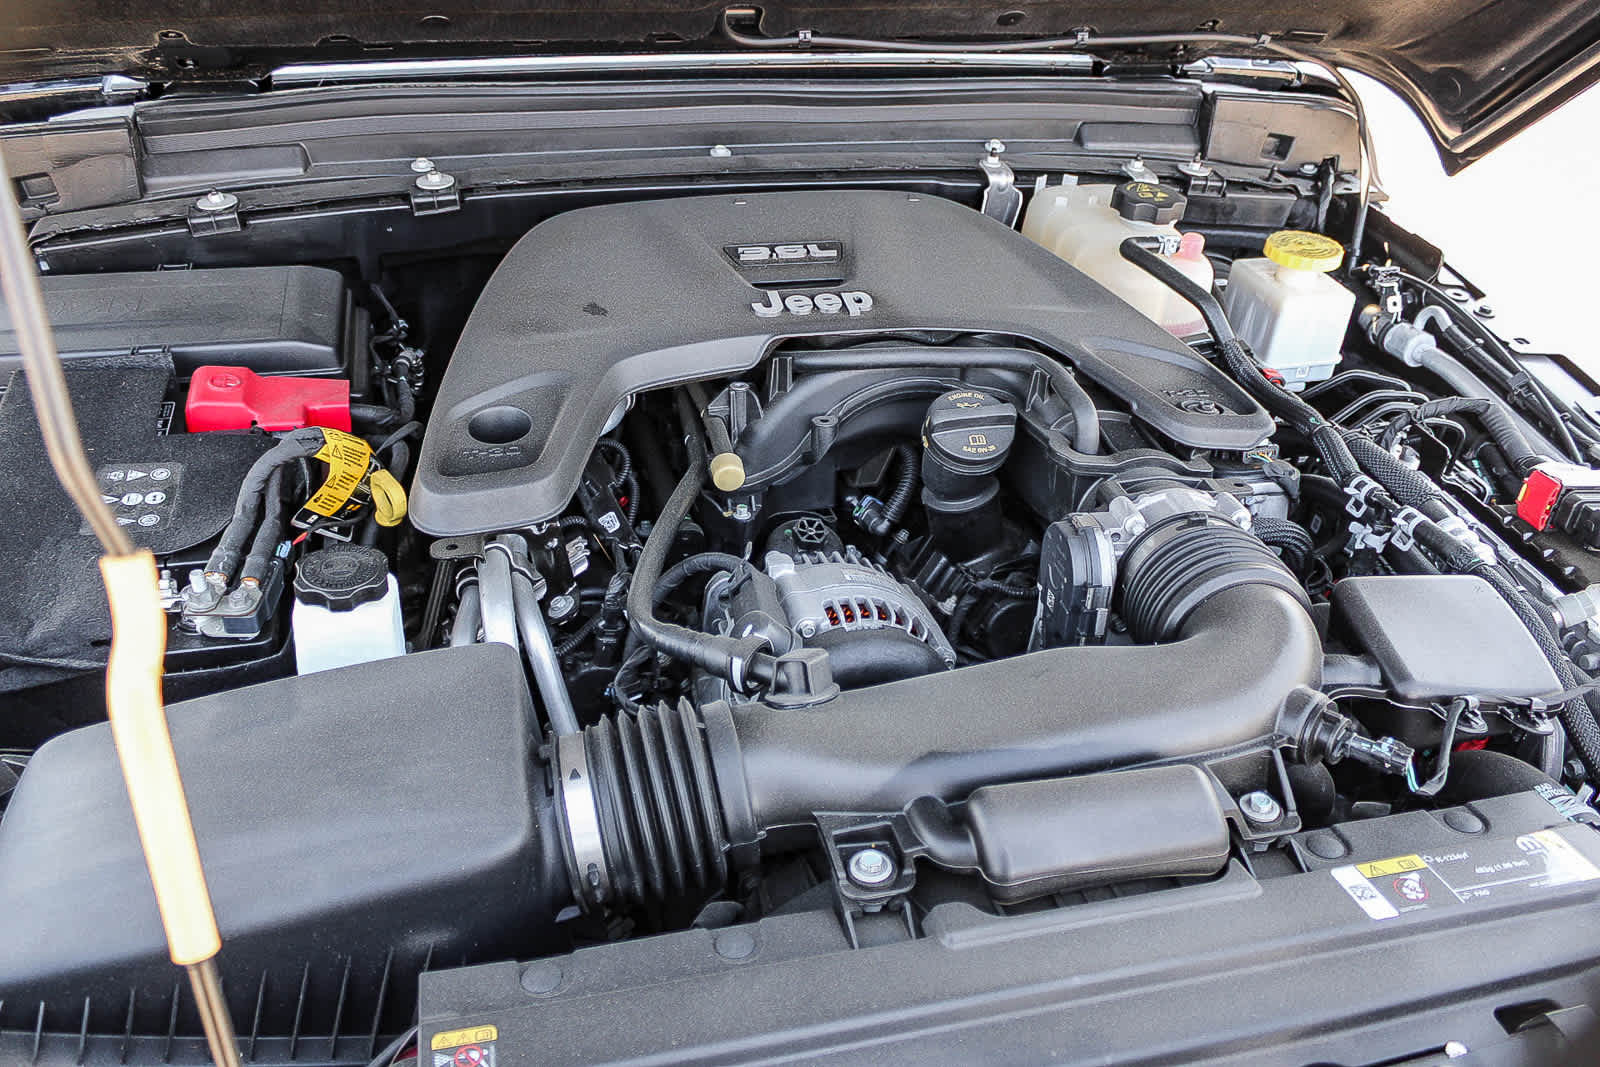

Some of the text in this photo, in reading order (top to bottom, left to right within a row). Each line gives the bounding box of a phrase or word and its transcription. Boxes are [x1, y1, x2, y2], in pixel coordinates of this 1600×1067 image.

[738, 243, 838, 261] 3.6L
[751, 290, 873, 318] Jeep
[947, 392, 985, 401] ENGINE OIL
